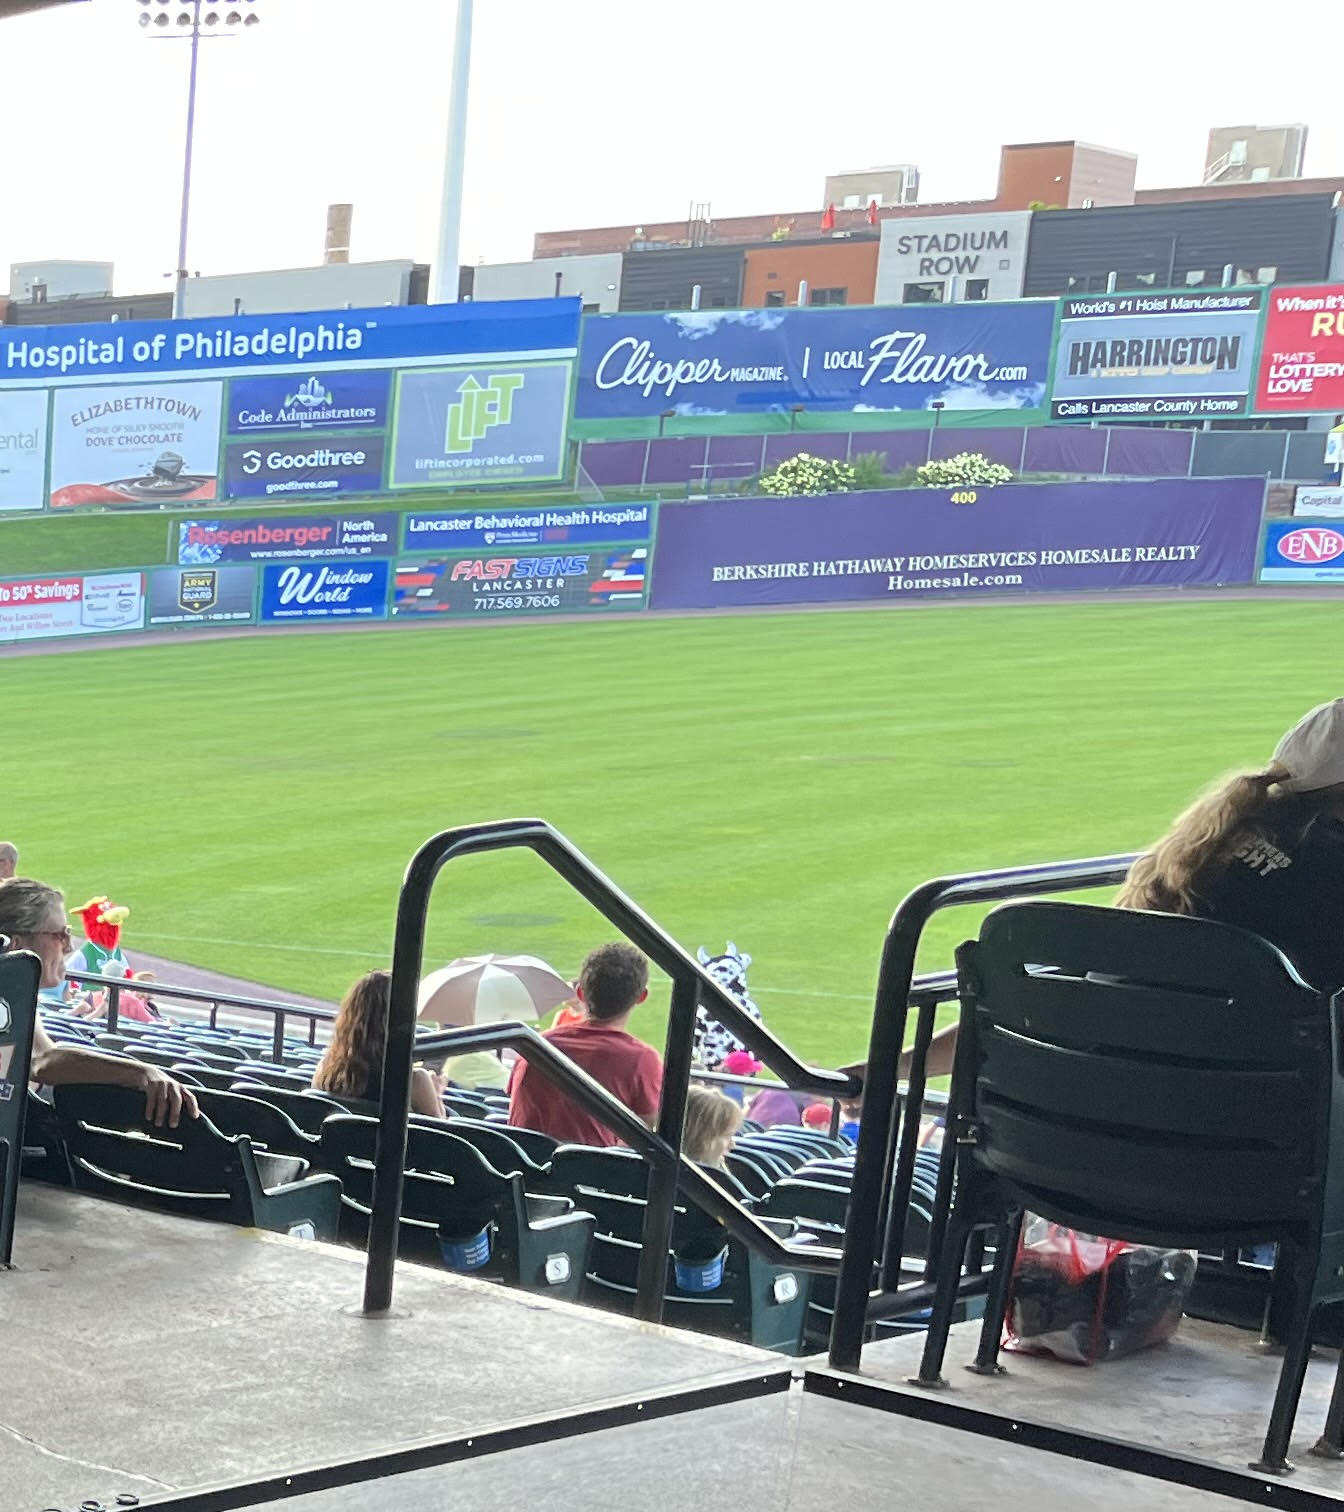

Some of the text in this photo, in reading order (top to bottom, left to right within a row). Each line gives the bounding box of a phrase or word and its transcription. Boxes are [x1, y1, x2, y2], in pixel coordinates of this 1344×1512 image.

[898, 230, 1008, 256] STADIUM
[919, 255, 980, 277] ROW
[1070, 301, 1115, 315] World's
[1135, 298, 1167, 312] Hoist
[1170, 295, 1253, 311] Manufacturer
[1277, 296, 1325, 312] When
[7, 336, 123, 372] Hospital
[133, 333, 166, 362] of
[175, 321, 364, 360] Philadelphia
[1068, 335, 1241, 376] HARRINGTON
[823, 351, 865, 371] LOCAL
[1272, 351, 1316, 363] THAT'S
[595, 336, 730, 398] Clipper
[1267, 378, 1314, 394] LOVE
[70, 396, 202, 428] ELIZABETHTOWN
[238, 406, 376, 424] Code Administrators
[1058, 397, 1238, 415] Calls Lancaster County Home
[85, 432, 184, 447] DOVE CHOCOLATE
[266, 449, 366, 470] Goodthree
[415, 453, 545, 471] liftincorporated.com
[265, 479, 339, 494] goodthree.com
[951, 491, 977, 504] 400
[343, 520, 374, 531] North
[410, 508, 647, 532] Lancaster Behavioral Health Hospital
[188, 525, 332, 546] Rosenberger
[342, 532, 387, 543] America
[1287, 532, 1338, 559] ENB
[450, 555, 590, 582] FASTSIGNS
[712, 545, 1200, 582] BERKSHIRE HATHAWAY HOMESERVICES HOMESALE REALTY
[34, 581, 80, 600] Savings
[473, 578, 565, 593] LANCASTER
[887, 572, 1023, 591] Homesale.com
[474, 595, 561, 611] 717.569.7606
